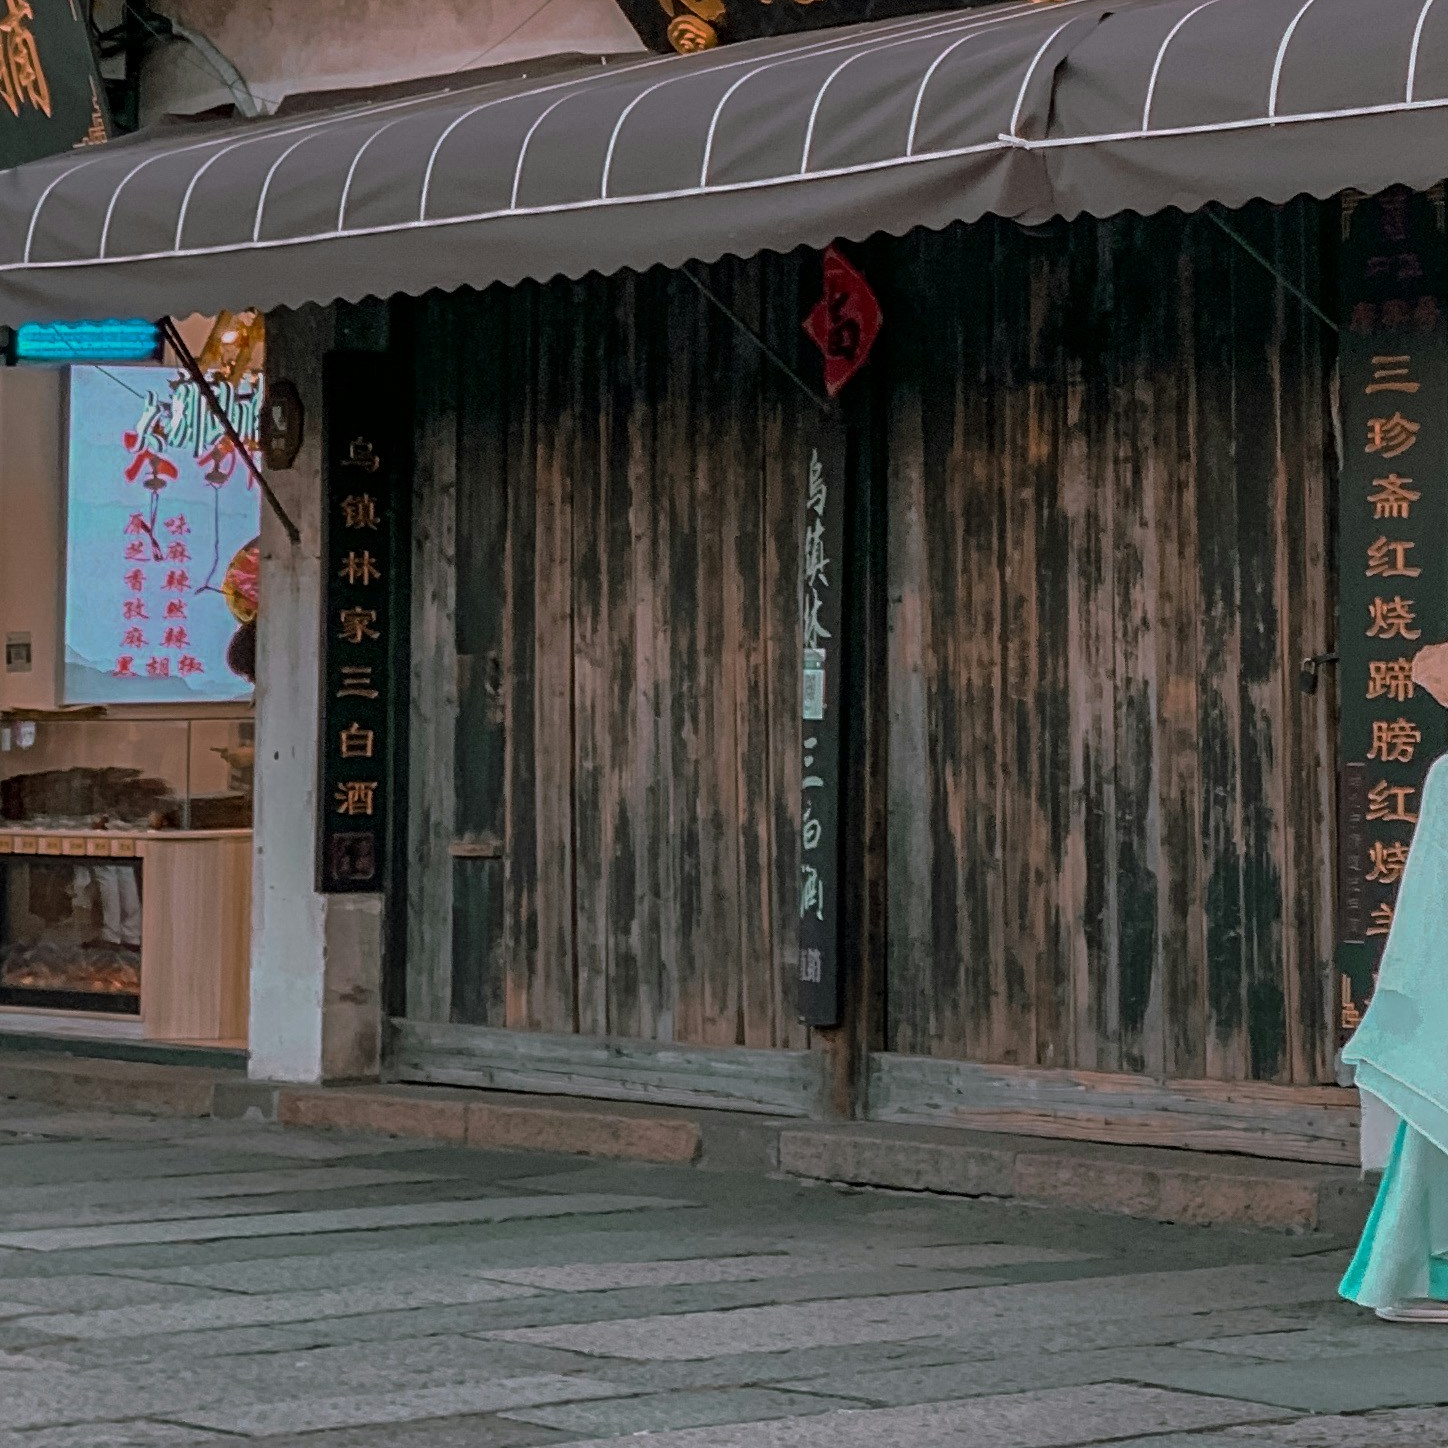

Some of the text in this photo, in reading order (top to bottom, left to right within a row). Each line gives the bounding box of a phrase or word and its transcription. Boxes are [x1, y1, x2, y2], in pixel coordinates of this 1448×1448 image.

[335, 436, 381, 816] 乌镇林家三白酒
